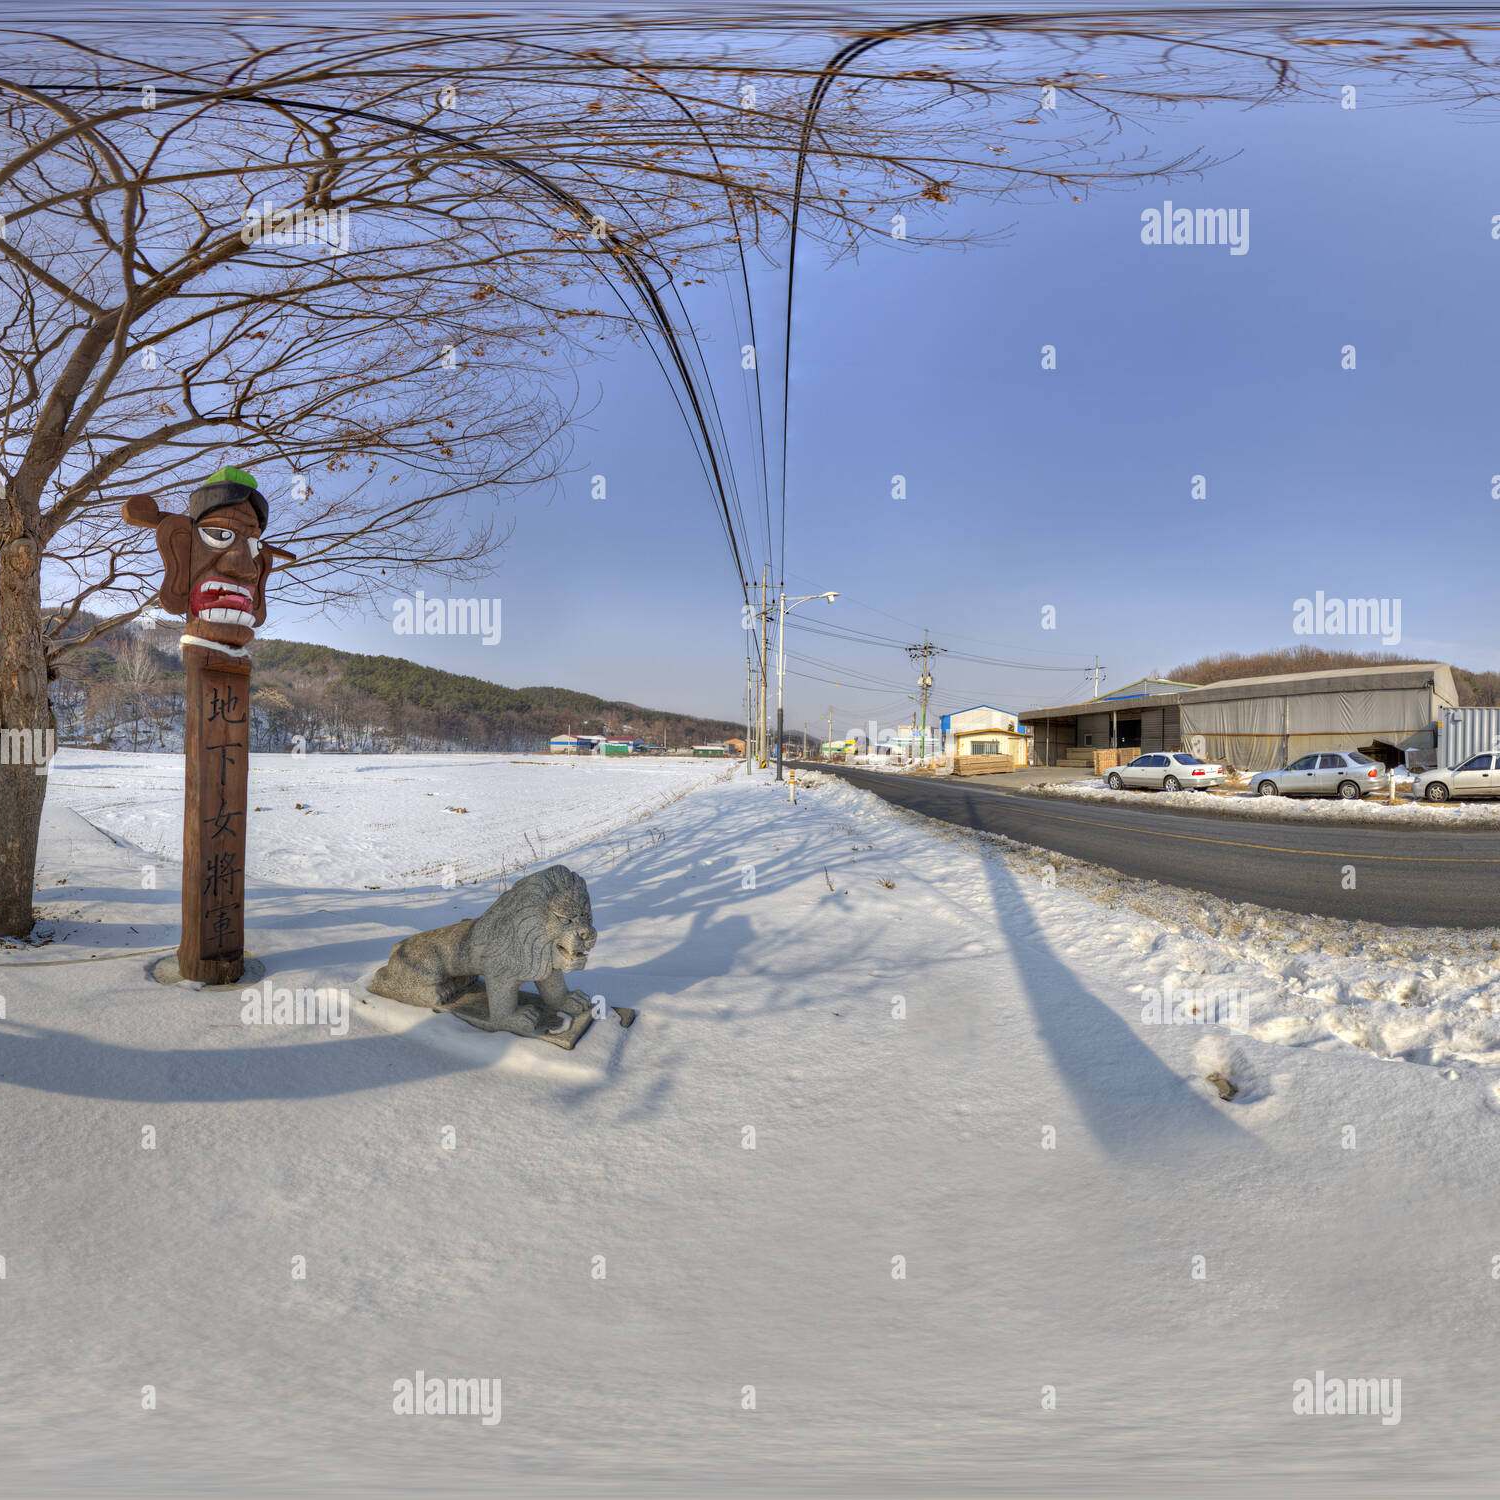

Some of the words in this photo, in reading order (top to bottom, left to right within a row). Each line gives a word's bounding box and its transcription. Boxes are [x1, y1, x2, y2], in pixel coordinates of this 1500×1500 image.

[203, 686, 246, 948] 地下女將軍
